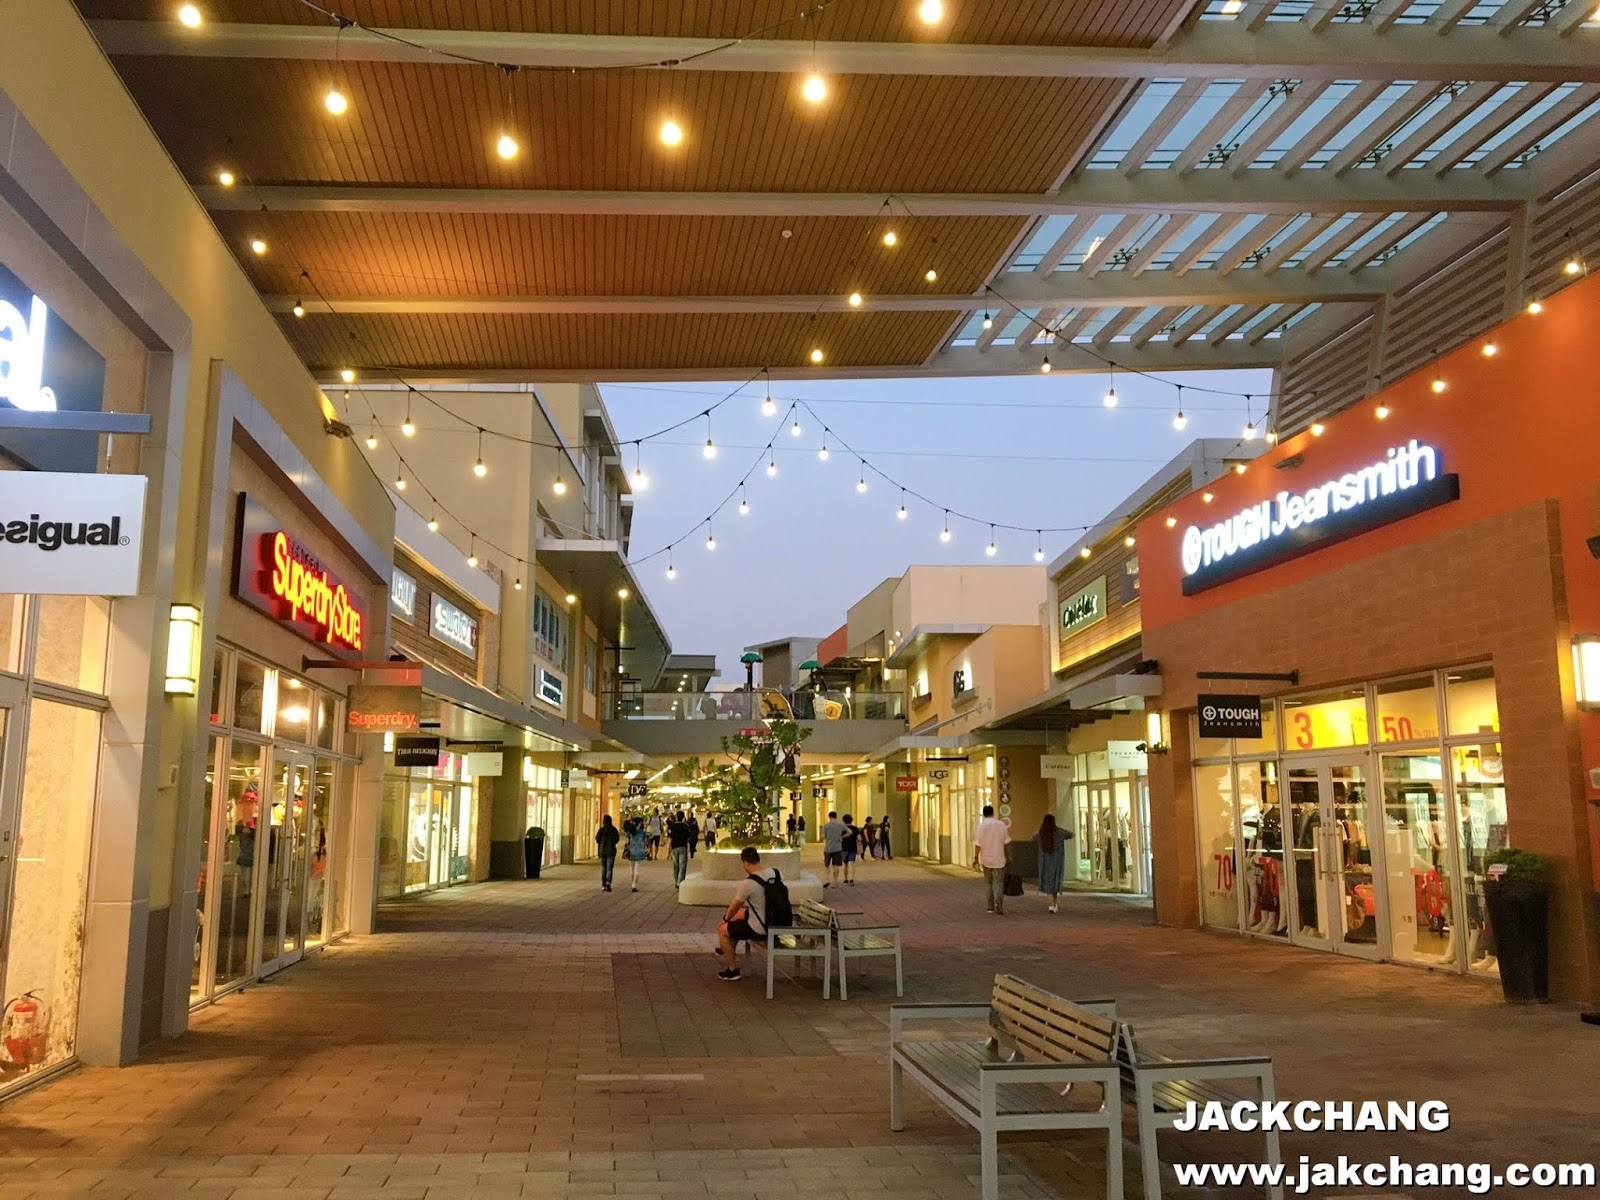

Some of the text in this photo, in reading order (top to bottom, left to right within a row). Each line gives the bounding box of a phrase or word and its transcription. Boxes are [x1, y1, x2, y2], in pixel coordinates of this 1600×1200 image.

[1202, 438, 1436, 567] TOUGH Jeansmith
[273, 531, 336, 643] Superdry
[1217, 708, 1260, 720] TOUGH
[1294, 712, 1314, 749] 3
[1382, 716, 1414, 742] 50
[929, 769, 949, 779] UGG
[1214, 854, 1232, 890] 70
